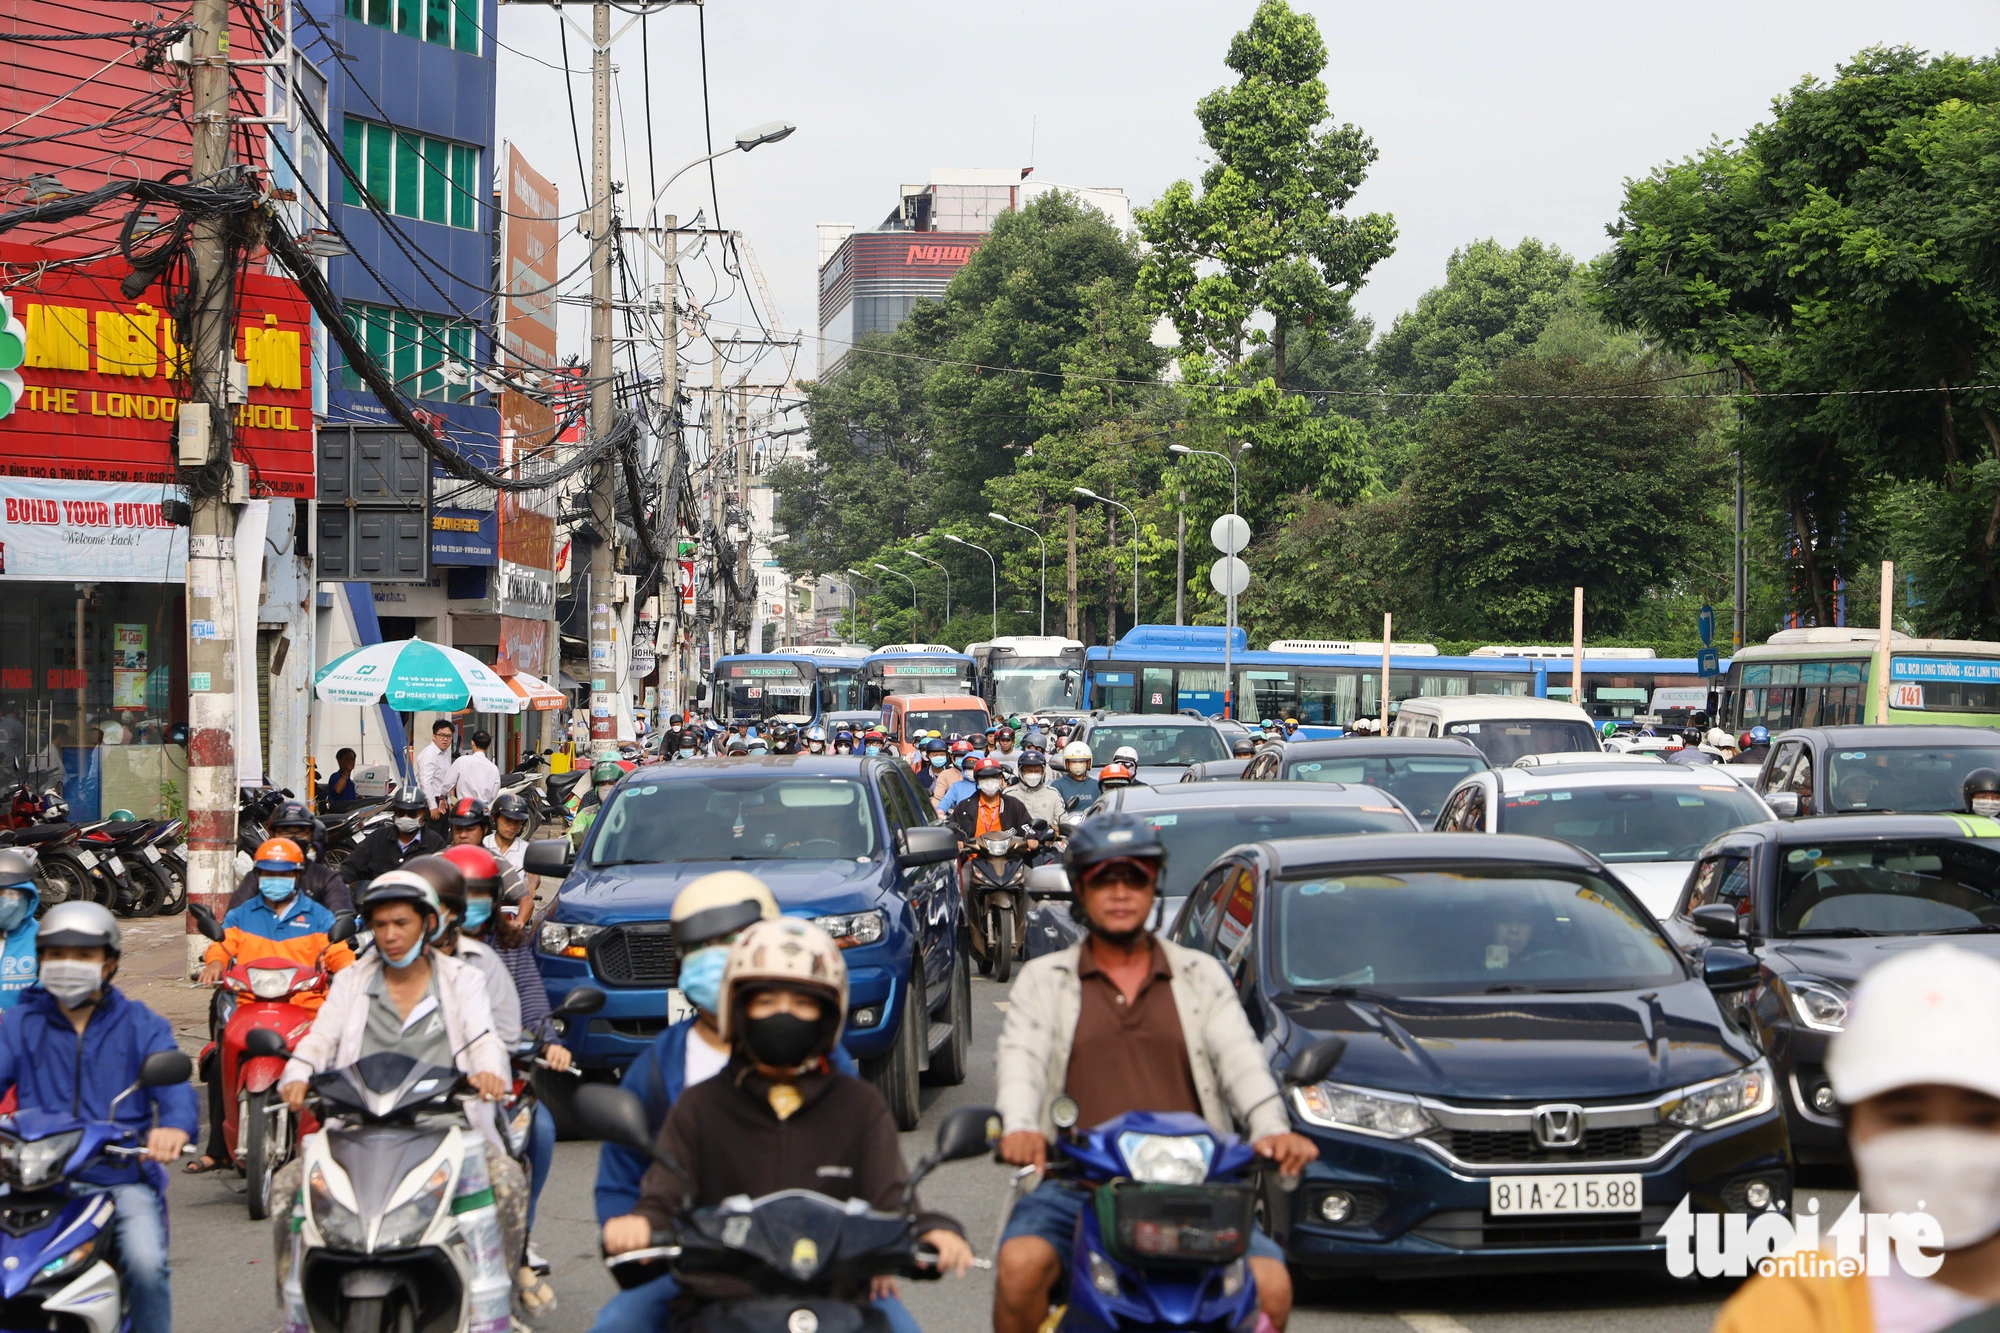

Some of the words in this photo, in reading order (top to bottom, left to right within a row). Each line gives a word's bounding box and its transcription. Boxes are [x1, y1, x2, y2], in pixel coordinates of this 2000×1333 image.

[24, 303, 90, 371] ANH
[25, 386, 79, 414] THE
[91, 391, 180, 422] LONDO
[232, 404, 299, 431] HOOL
[9, 462, 28, 477] BÌNH
[110, 471, 128, 482] HCM
[5, 497, 60, 526] BUILD
[62, 500, 111, 528] YOUR
[114, 502, 178, 530] FUTUR
[61, 531, 106, 545] Welcome
[107, 532, 134, 546] Back
[634, 649, 654, 657] JOHN
[1895, 663, 1907, 675] KDL
[1921, 663, 1936, 676] LONG
[1937, 661, 1960, 677] TRƯỜNG
[1964, 665, 1976, 677] KCX
[1977, 666, 1991, 678] LINH
[749, 689, 760, 698] 56
[1152, 693, 1161, 704] 53
[1661, 692, 1706, 700] LUXURY
[1901, 686, 1921, 706] 141
[1497, 1180, 1636, 1210] 81A-215.88
